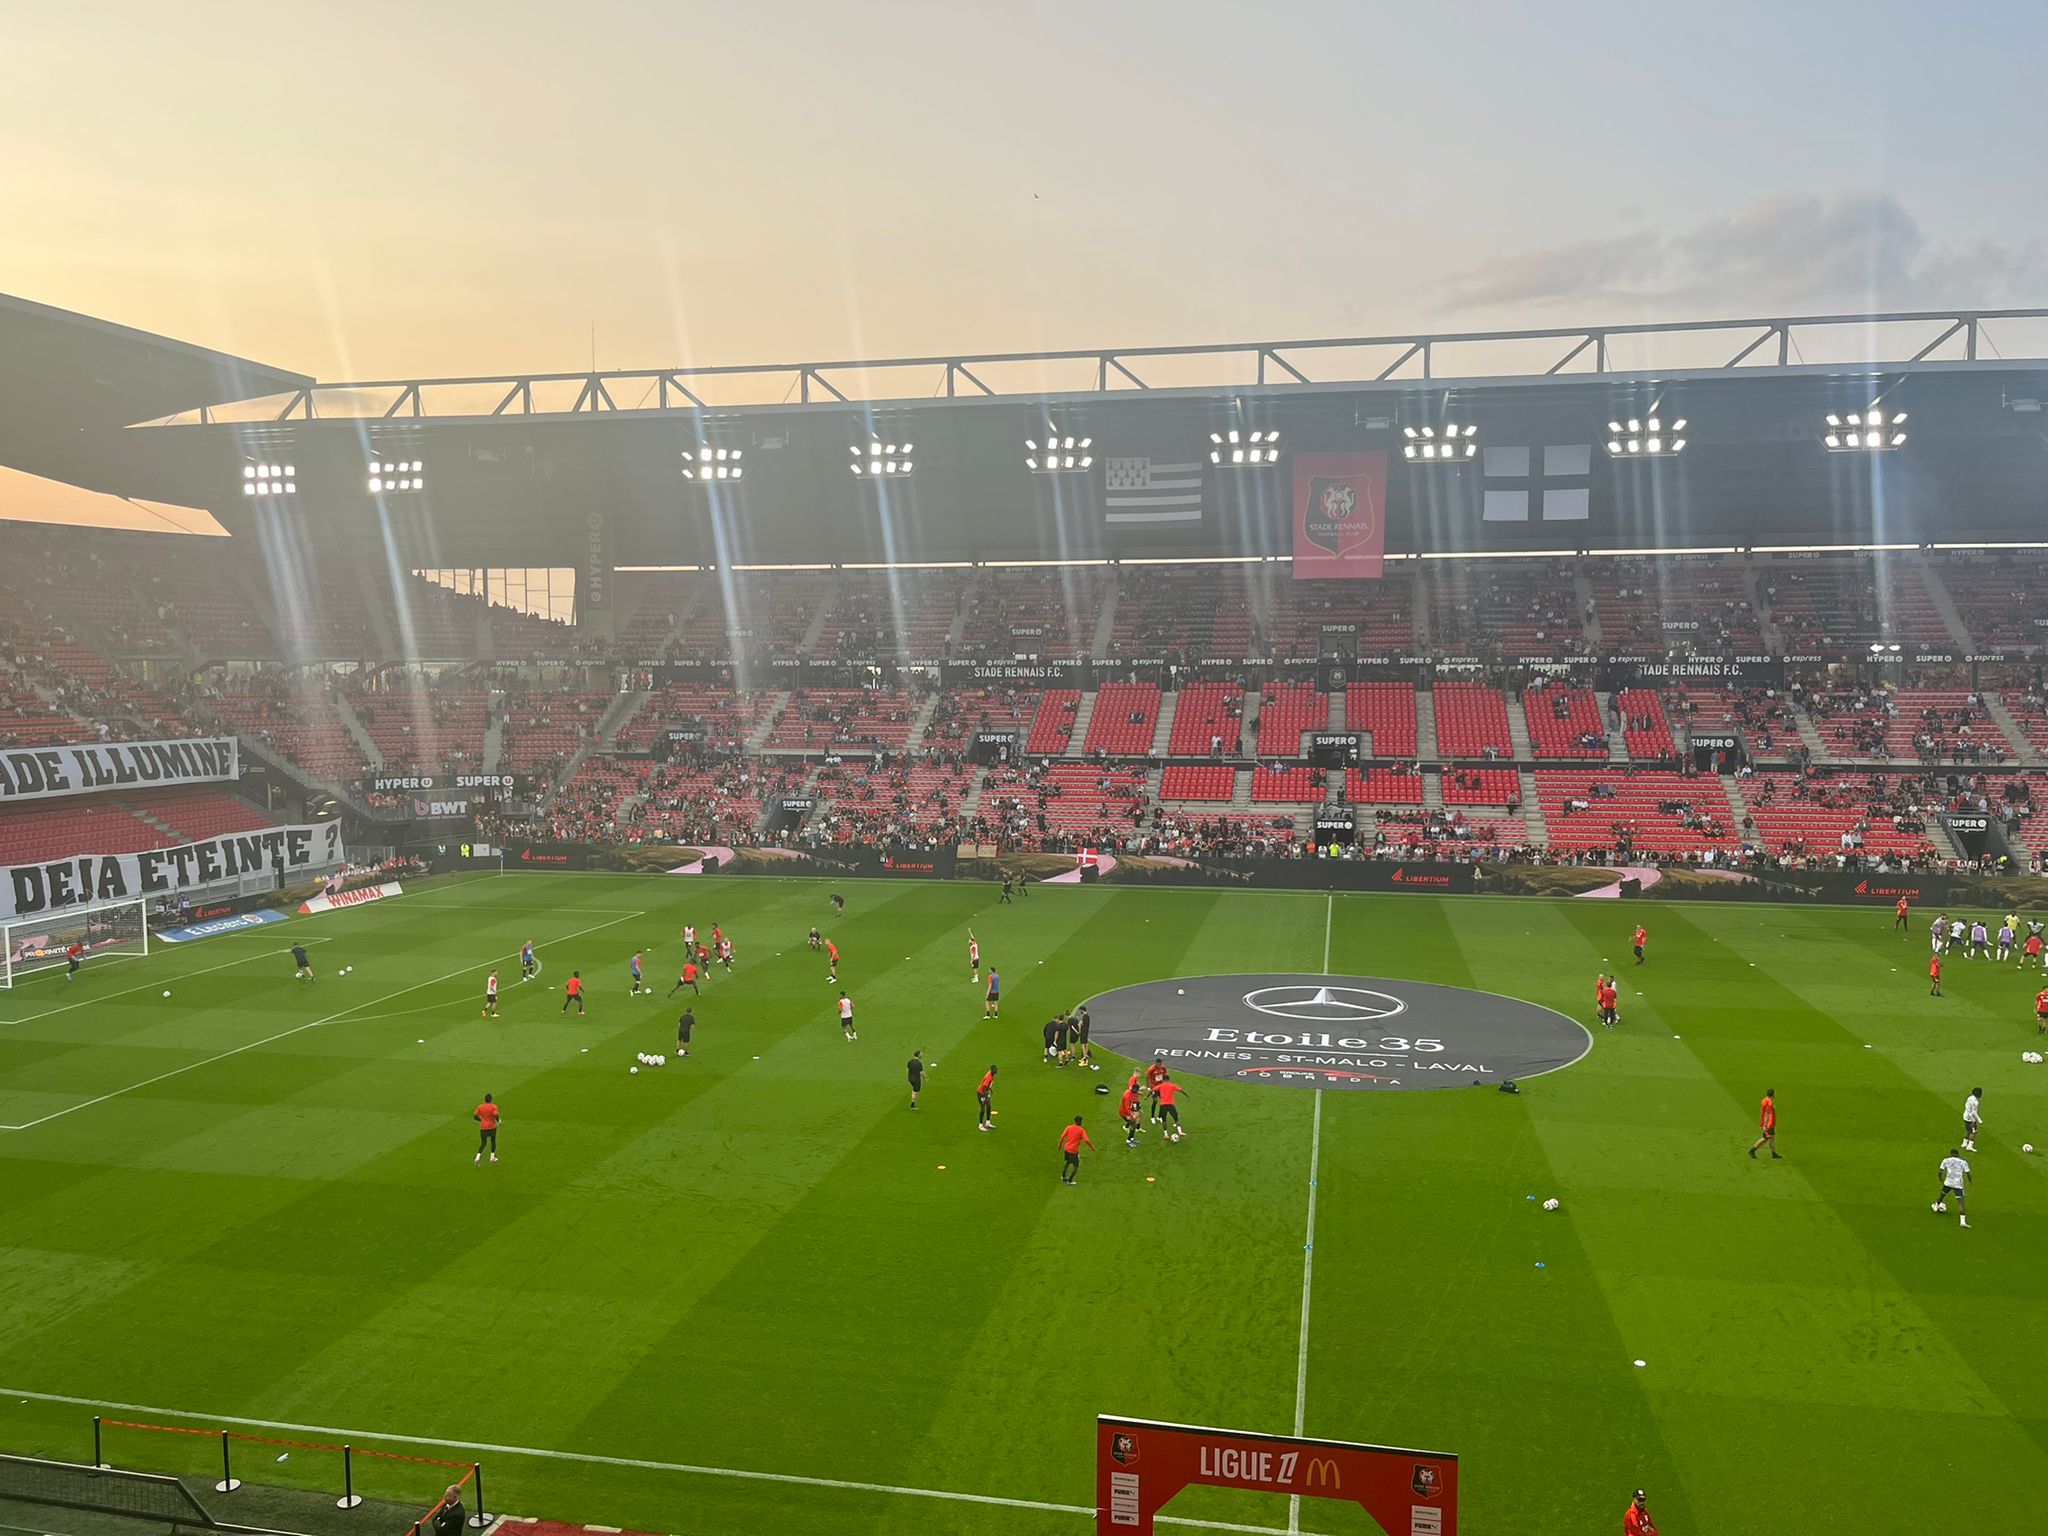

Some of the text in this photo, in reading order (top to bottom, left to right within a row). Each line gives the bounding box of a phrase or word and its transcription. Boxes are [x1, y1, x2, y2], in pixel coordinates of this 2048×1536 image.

[1617, 655, 1646, 663] express
[1792, 655, 1821, 663] express
[1974, 654, 2004, 662] express
[975, 667, 1063, 678] STADE RENNAIS F.C.
[1672, 665, 1720, 676] RENNAIS
[1723, 665, 1743, 676] F.C.
[668, 732, 695, 740] SUPER
[979, 734, 1007, 743] SUPER
[1315, 737, 1347, 745] SUPER
[71, 742, 232, 788] ILLUMINE
[375, 777, 420, 790] HYPER
[456, 776, 500, 787] SUPER
[430, 801, 467, 815] BWT
[782, 800, 805, 808] SUPER
[1316, 821, 1345, 829] SUPER
[10, 824, 338, 914] DEJA ETEINTE ?
[327, 885, 384, 908] WINAMAX
[1202, 1027, 1445, 1053] Etoile 35
[1153, 1048, 1252, 1060] RENNES
[1276, 1054, 1388, 1068] ST-MALO
[1413, 1061, 1494, 1073] LAVAL
[1200, 1446, 1273, 1483] LIGUE
